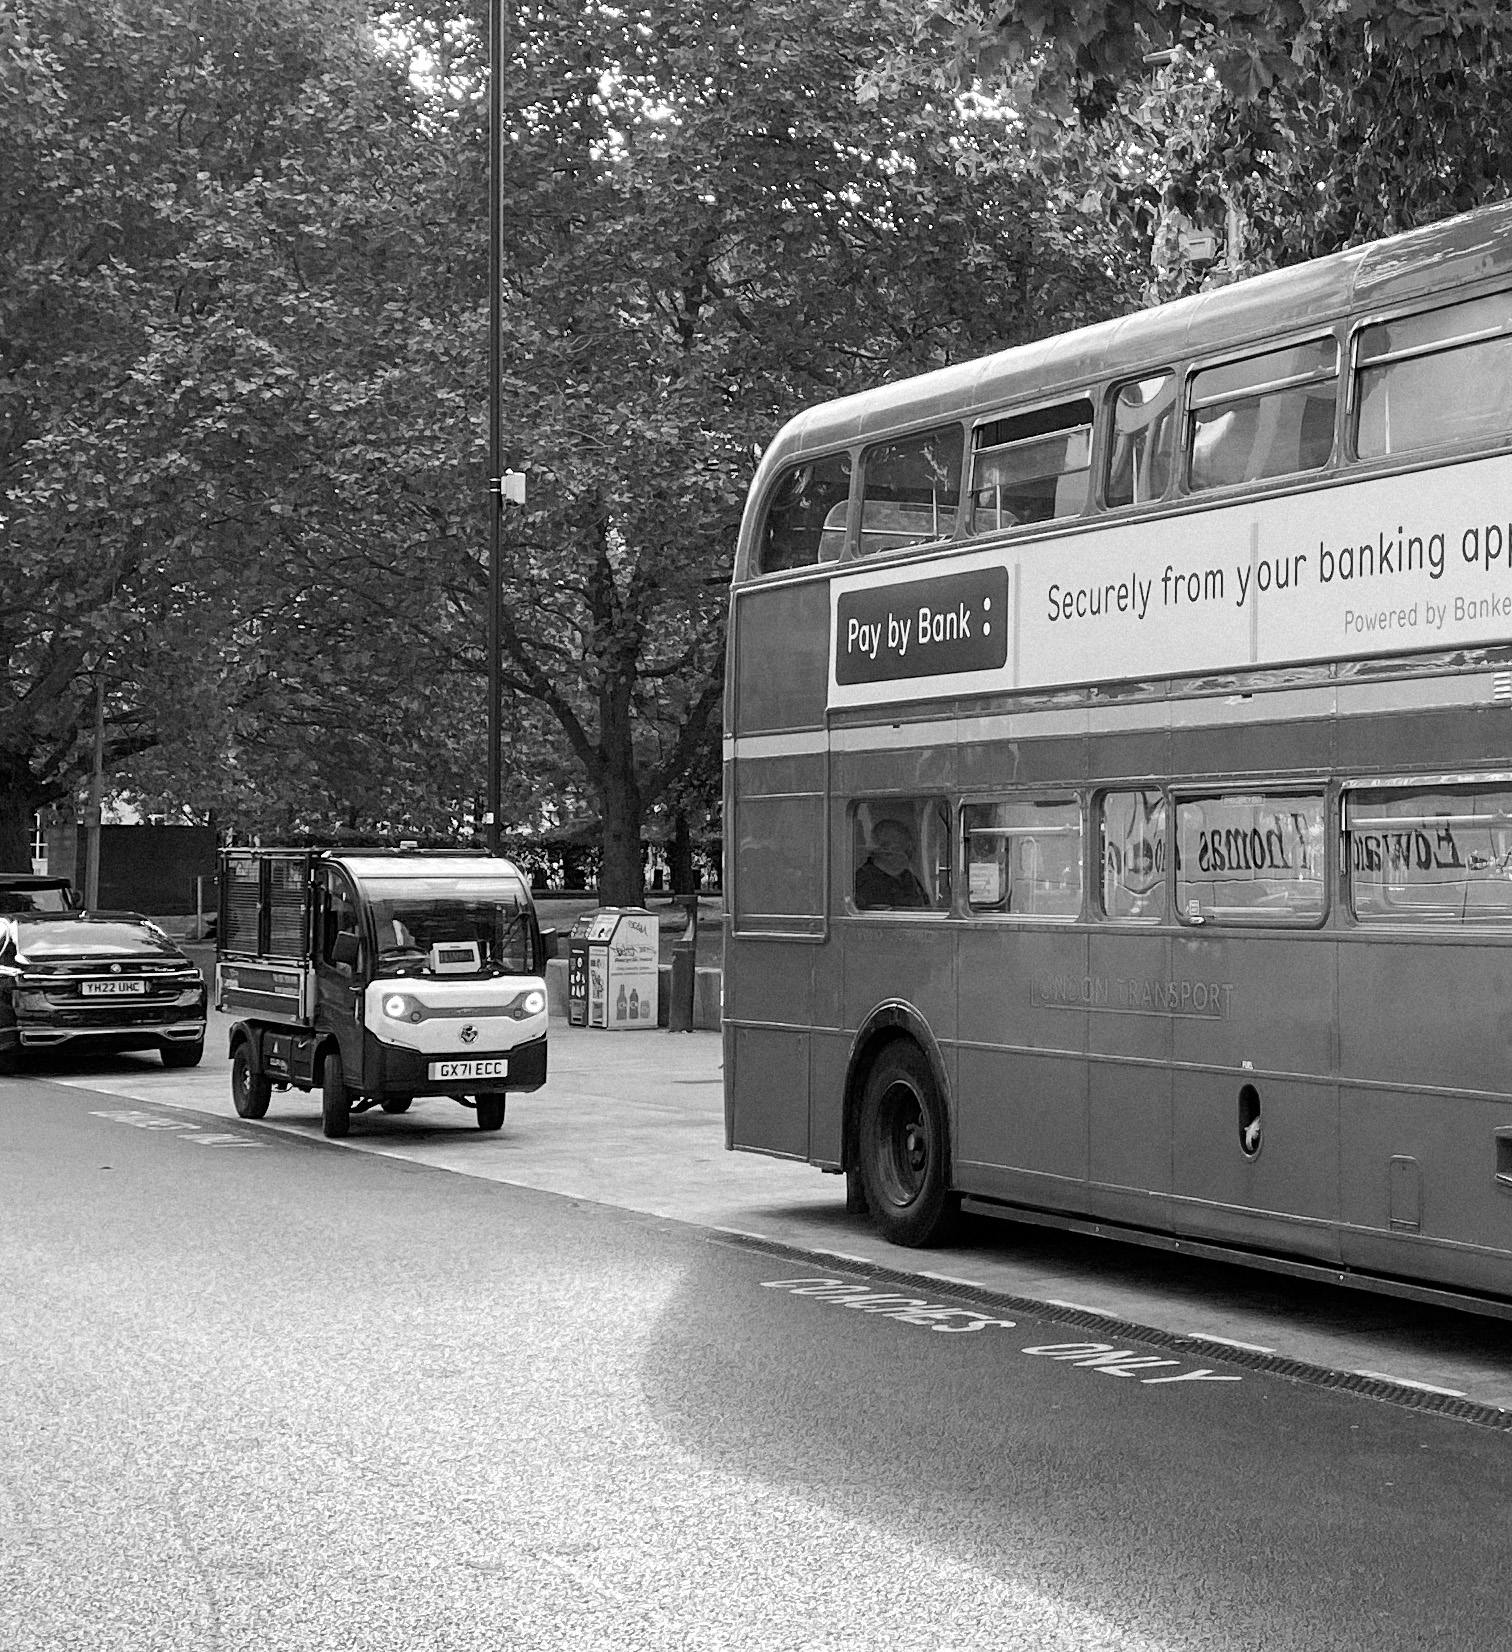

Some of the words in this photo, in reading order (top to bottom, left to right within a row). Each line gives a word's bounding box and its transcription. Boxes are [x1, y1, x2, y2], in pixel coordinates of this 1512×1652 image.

[1048, 572, 1151, 622] Securely
[1161, 565, 1224, 606] from
[1236, 554, 1307, 607] your
[1320, 526, 1445, 583] banking
[848, 618, 881, 660] Pay
[888, 612, 911, 656] by
[918, 602, 971, 644] Bank
[1344, 602, 1418, 634] Powered
[1426, 601, 1447, 630] by
[441, 1063, 472, 1077] GX71
[476, 1062, 502, 1076] ECC
[760, 1278, 1016, 1333] COACHES
[1022, 1343, 1242, 1384] ONLY
